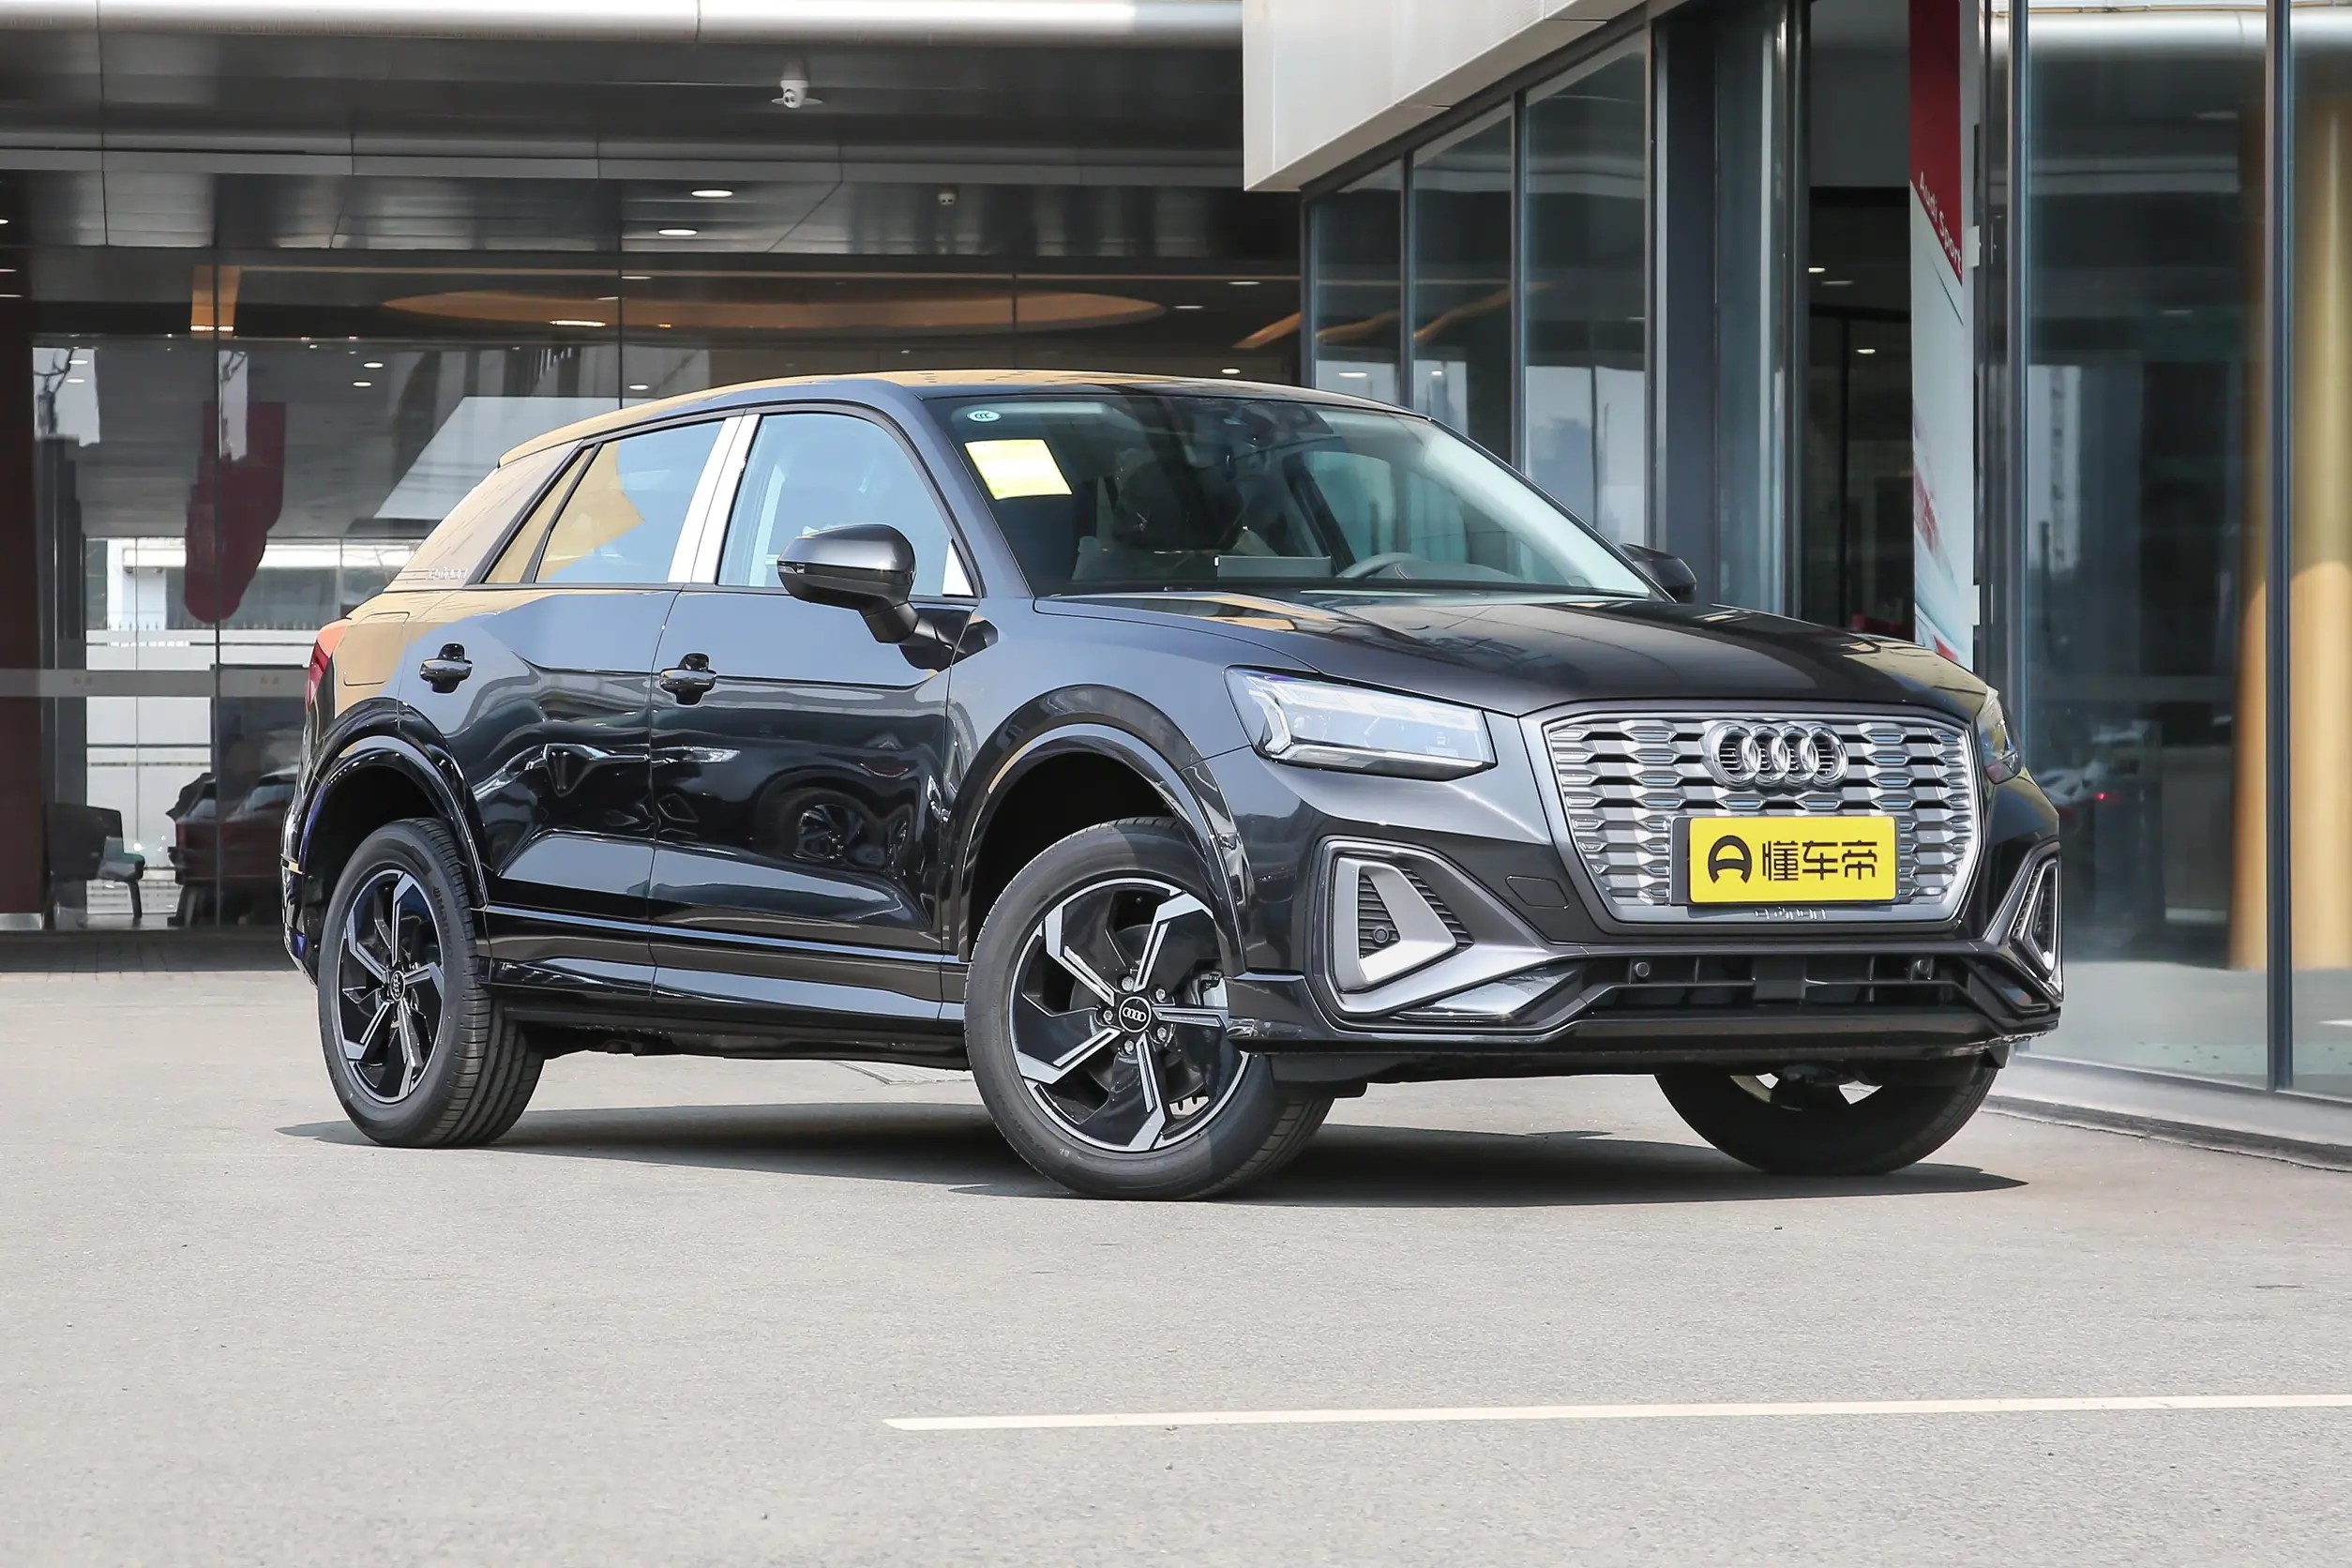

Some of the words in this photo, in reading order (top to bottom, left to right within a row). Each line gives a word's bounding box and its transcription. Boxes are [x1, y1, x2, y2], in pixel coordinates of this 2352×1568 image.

[1920, 171, 1937, 222] Audi
[1939, 210, 1962, 274] Sport
[1762, 840, 1878, 882] 懂车帝
